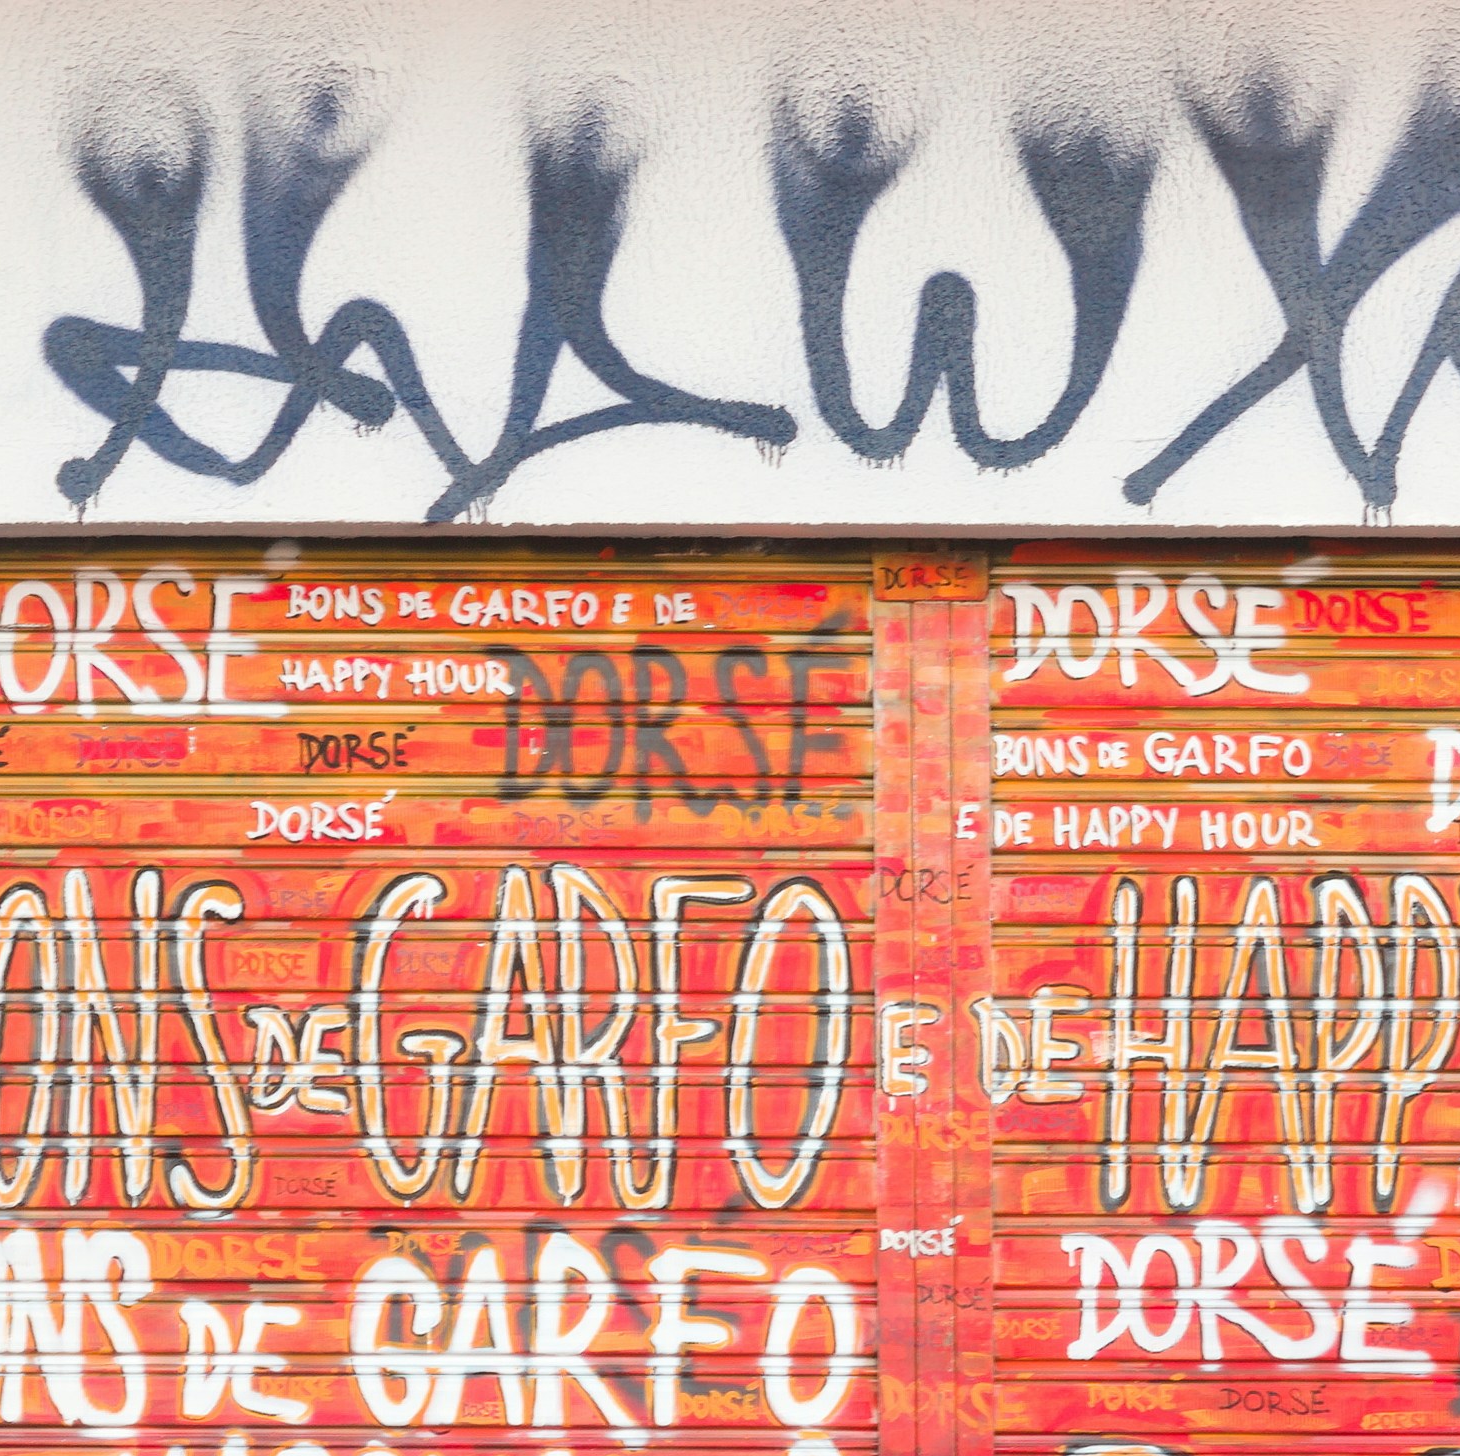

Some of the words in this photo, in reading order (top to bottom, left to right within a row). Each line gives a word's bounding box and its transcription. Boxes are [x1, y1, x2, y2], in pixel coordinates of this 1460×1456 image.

[286, 583, 384, 626] BONS
[398, 590, 436, 620] DE
[449, 585, 598, 628] GARFO
[611, 592, 633, 624] E
[655, 592, 698, 625] DE
[279, 658, 393, 699] HAPPY
[405, 658, 517, 697] HOUR
[991, 733, 1090, 777] BONS
[1097, 739, 1130, 771] DE
[1143, 731, 1313, 778] GARFO
[954, 803, 982, 841] E
[993, 809, 1035, 847] DE
[1053, 805, 1181, 850] HAPPY
[1201, 808, 1322, 851] HOUR
[247, 1003, 353, 1118] DE
[356, 862, 856, 1212] GARFO
[879, 1001, 941, 1098] E
[968, 984, 1093, 1105] DE
[178, 1298, 313, 1425] DE
[349, 1230, 859, 1440] GARFO
